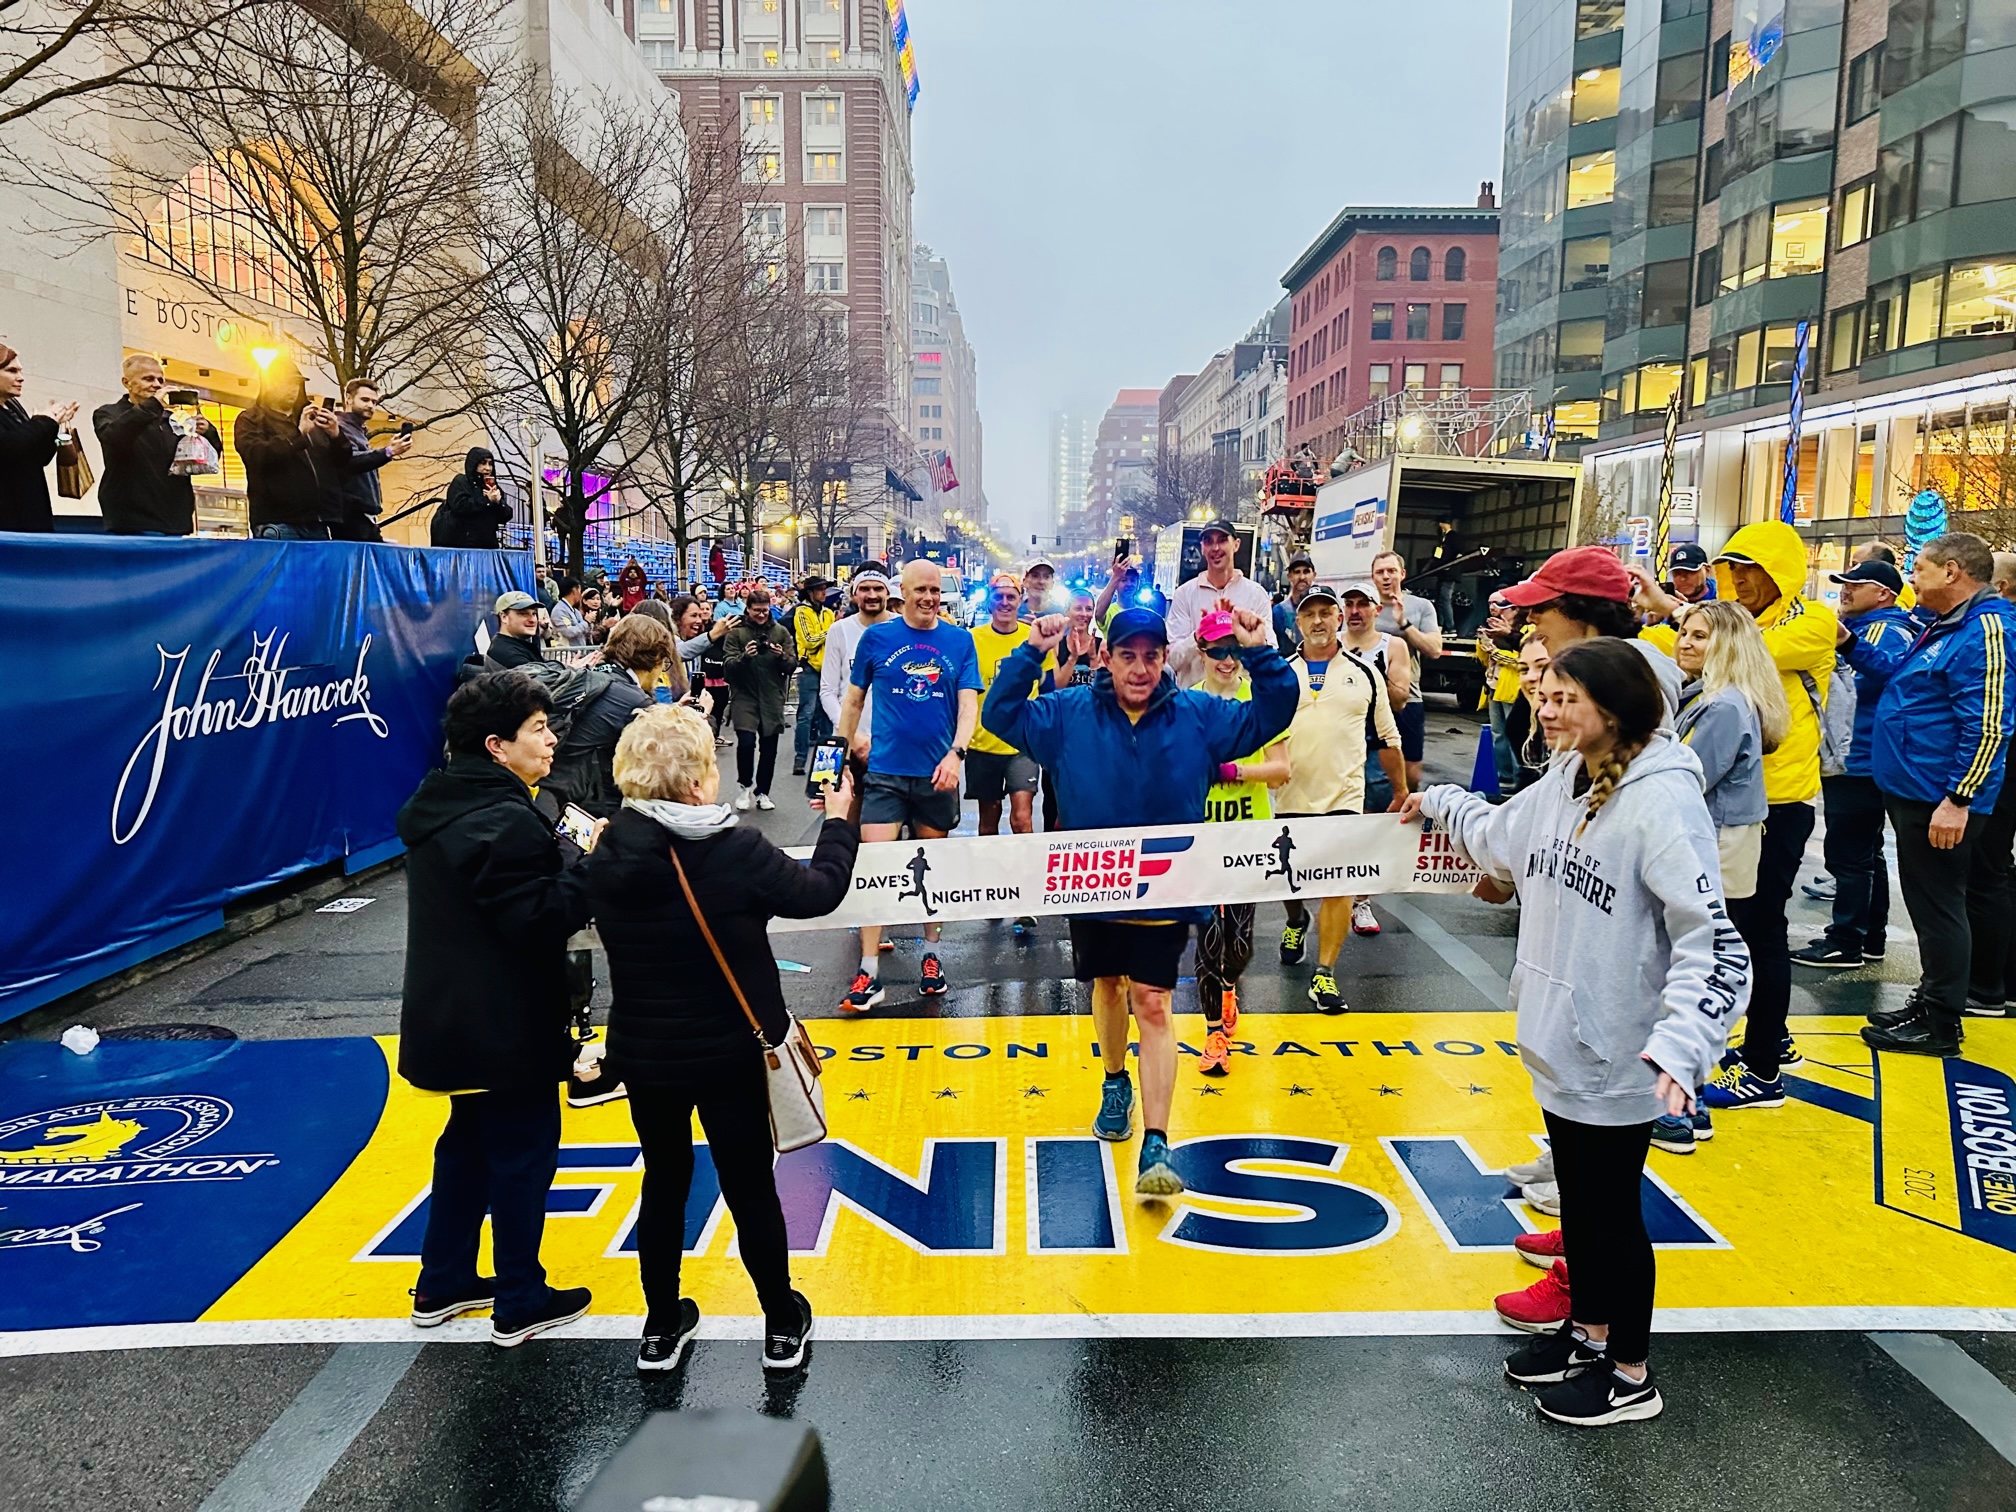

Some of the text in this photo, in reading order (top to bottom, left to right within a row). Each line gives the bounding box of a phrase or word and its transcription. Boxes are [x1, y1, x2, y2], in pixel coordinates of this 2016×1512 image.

[157, 298, 247, 346] BOSTON
[1354, 510, 1376, 527] PENSKE
[112, 643, 240, 844] John
[1050, 839, 1136, 851] DAVE MCGILLIVRAY
[1047, 849, 1135, 873] FINISH
[1223, 853, 1276, 868] DAVE'S
[1585, 854, 1601, 872] OF
[856, 874, 910, 890] DAVE'S
[1045, 872, 1132, 891] STRONG
[1296, 865, 1380, 881] NIGHT RUN
[932, 887, 1020, 904] NIGHT RUN
[1043, 890, 1131, 905] FOUNDATION
[48, 1098, 222, 1154] ATHLETIC ASSOCIATION
[1955, 1082, 2016, 1174] BOSTON
[1904, 1167, 1936, 1201] 2013
